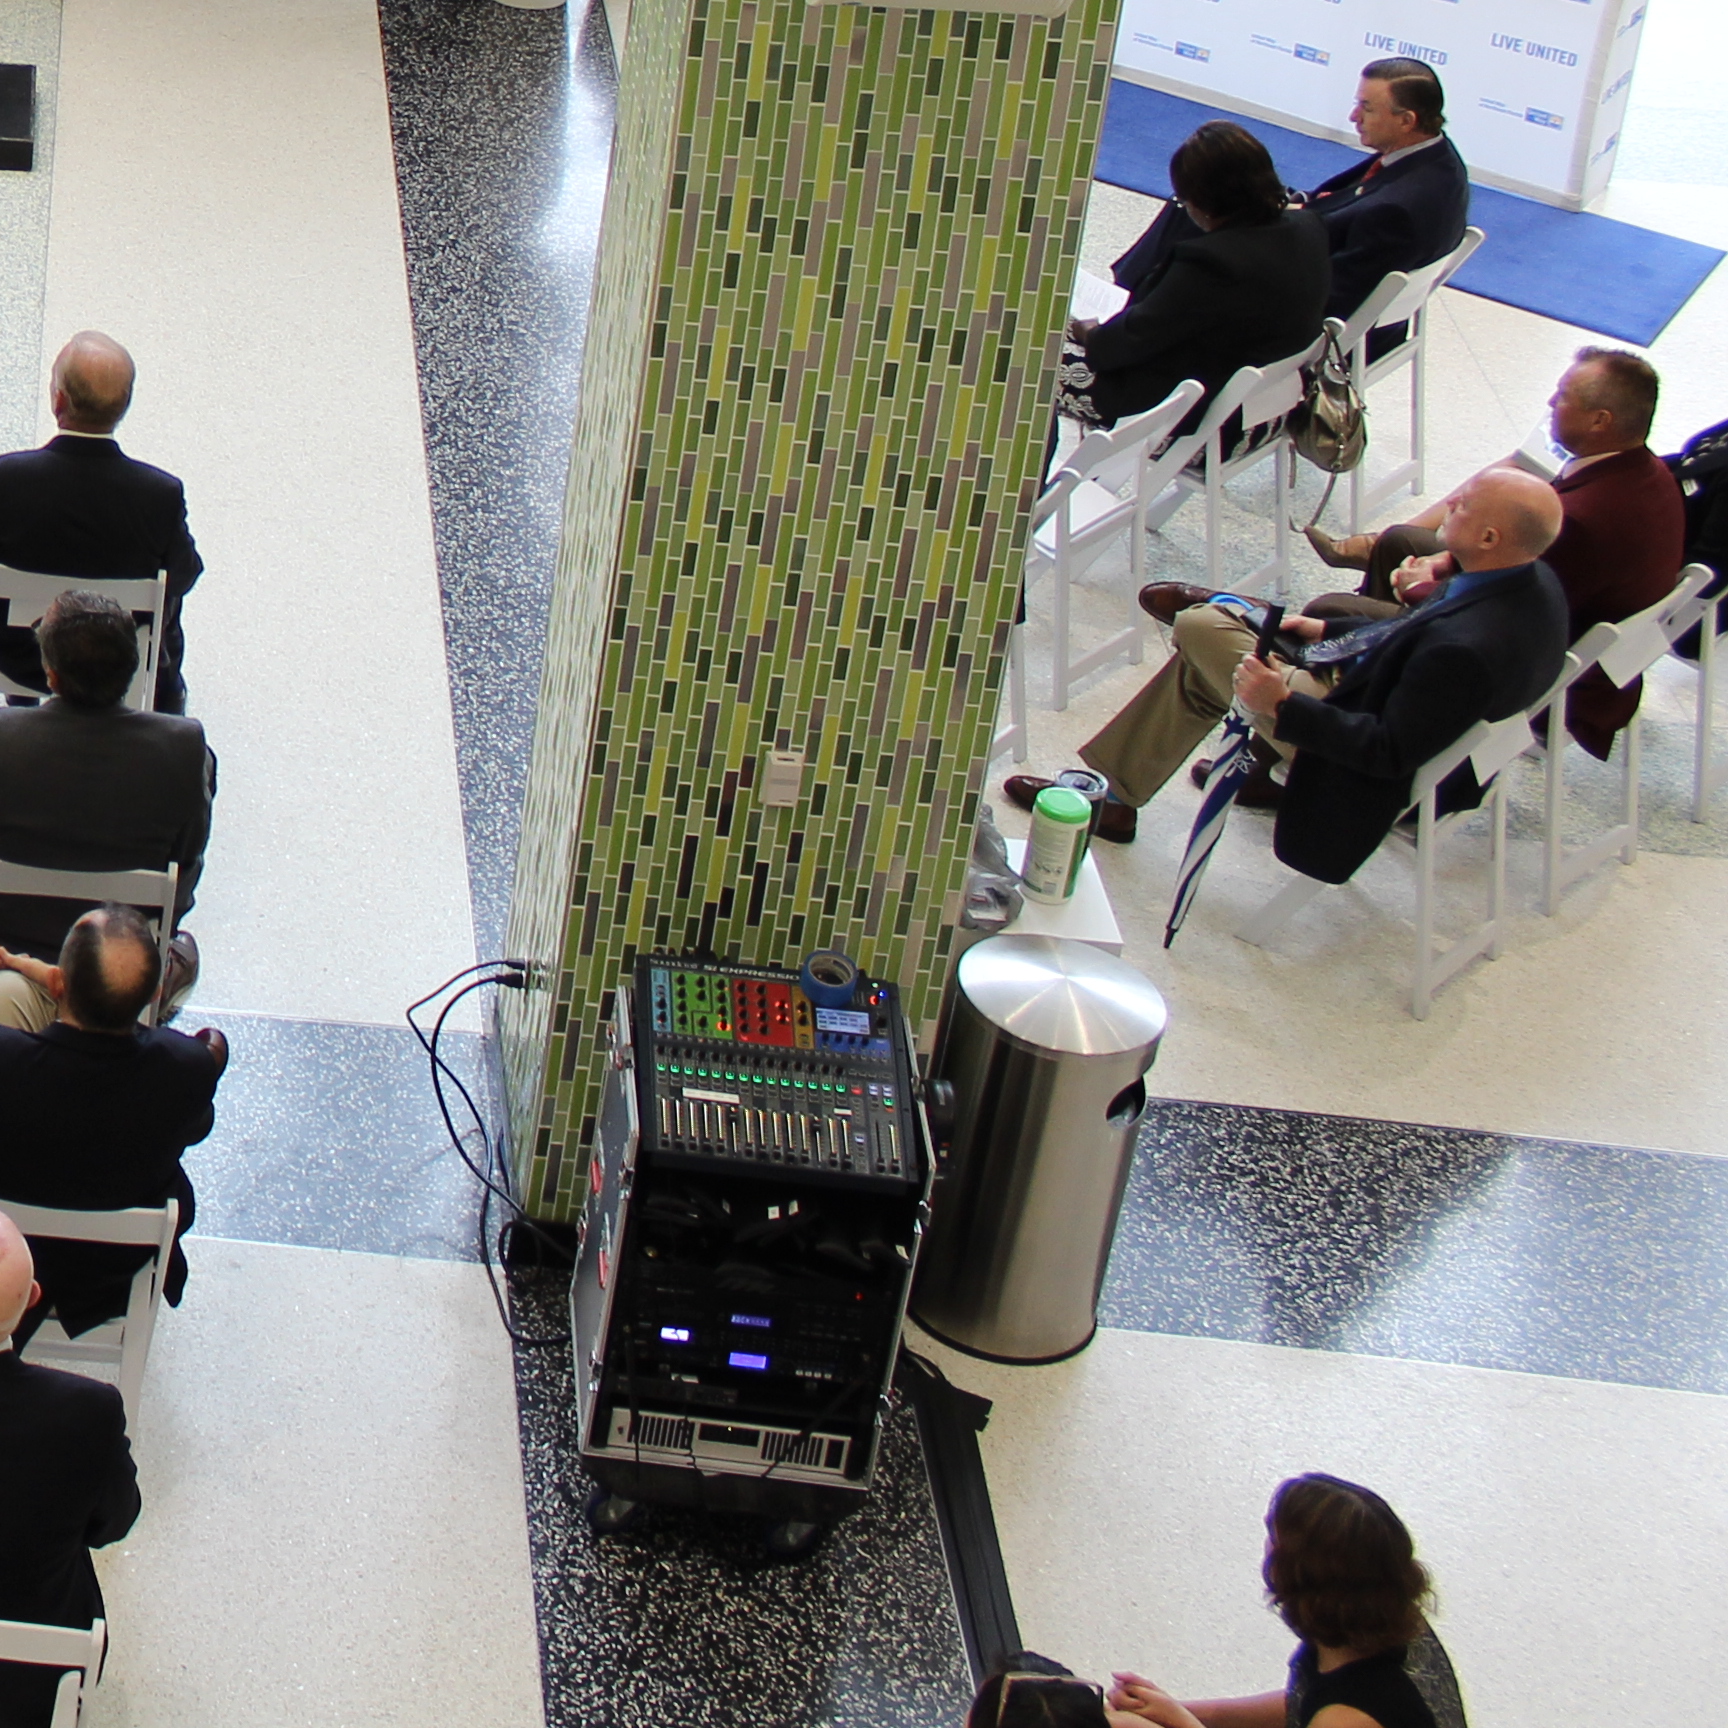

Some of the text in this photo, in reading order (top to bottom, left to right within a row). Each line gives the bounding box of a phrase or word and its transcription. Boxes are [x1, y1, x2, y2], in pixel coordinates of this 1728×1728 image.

[1364, 32, 1448, 66] LIVE UNITED
[1491, 33, 1578, 67] LIVE UNITED
